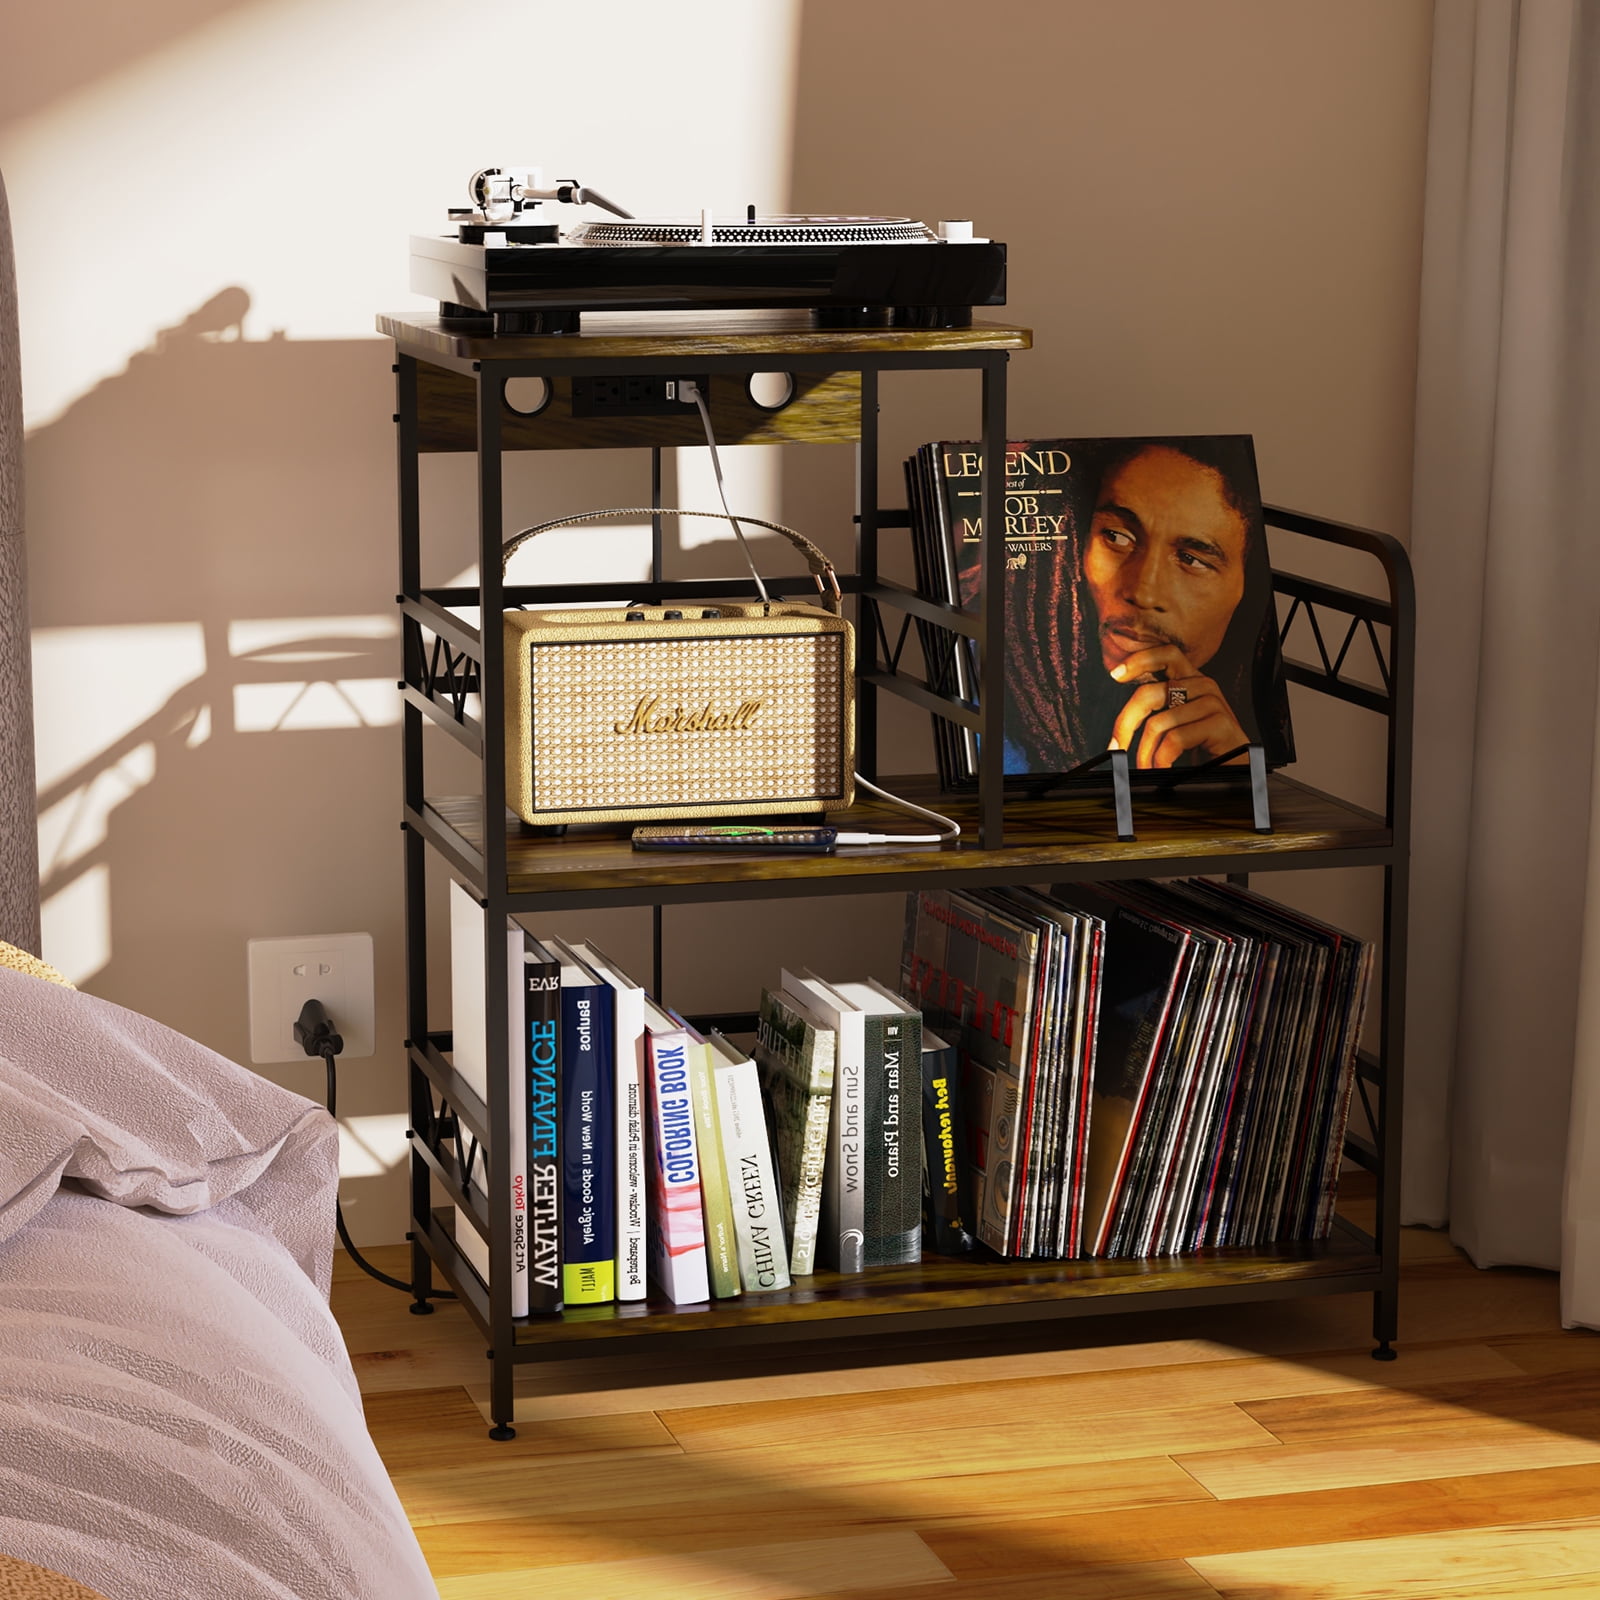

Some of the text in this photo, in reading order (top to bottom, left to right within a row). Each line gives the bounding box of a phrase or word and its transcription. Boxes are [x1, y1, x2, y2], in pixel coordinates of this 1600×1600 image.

[943, 450, 1071, 478] LEEND
[1018, 478, 1026, 489] of
[1005, 496, 1039, 516] OB
[962, 515, 1064, 537] MRLEY
[1008, 542, 1053, 552] WAILERS
[614, 694, 764, 735] Marshall
